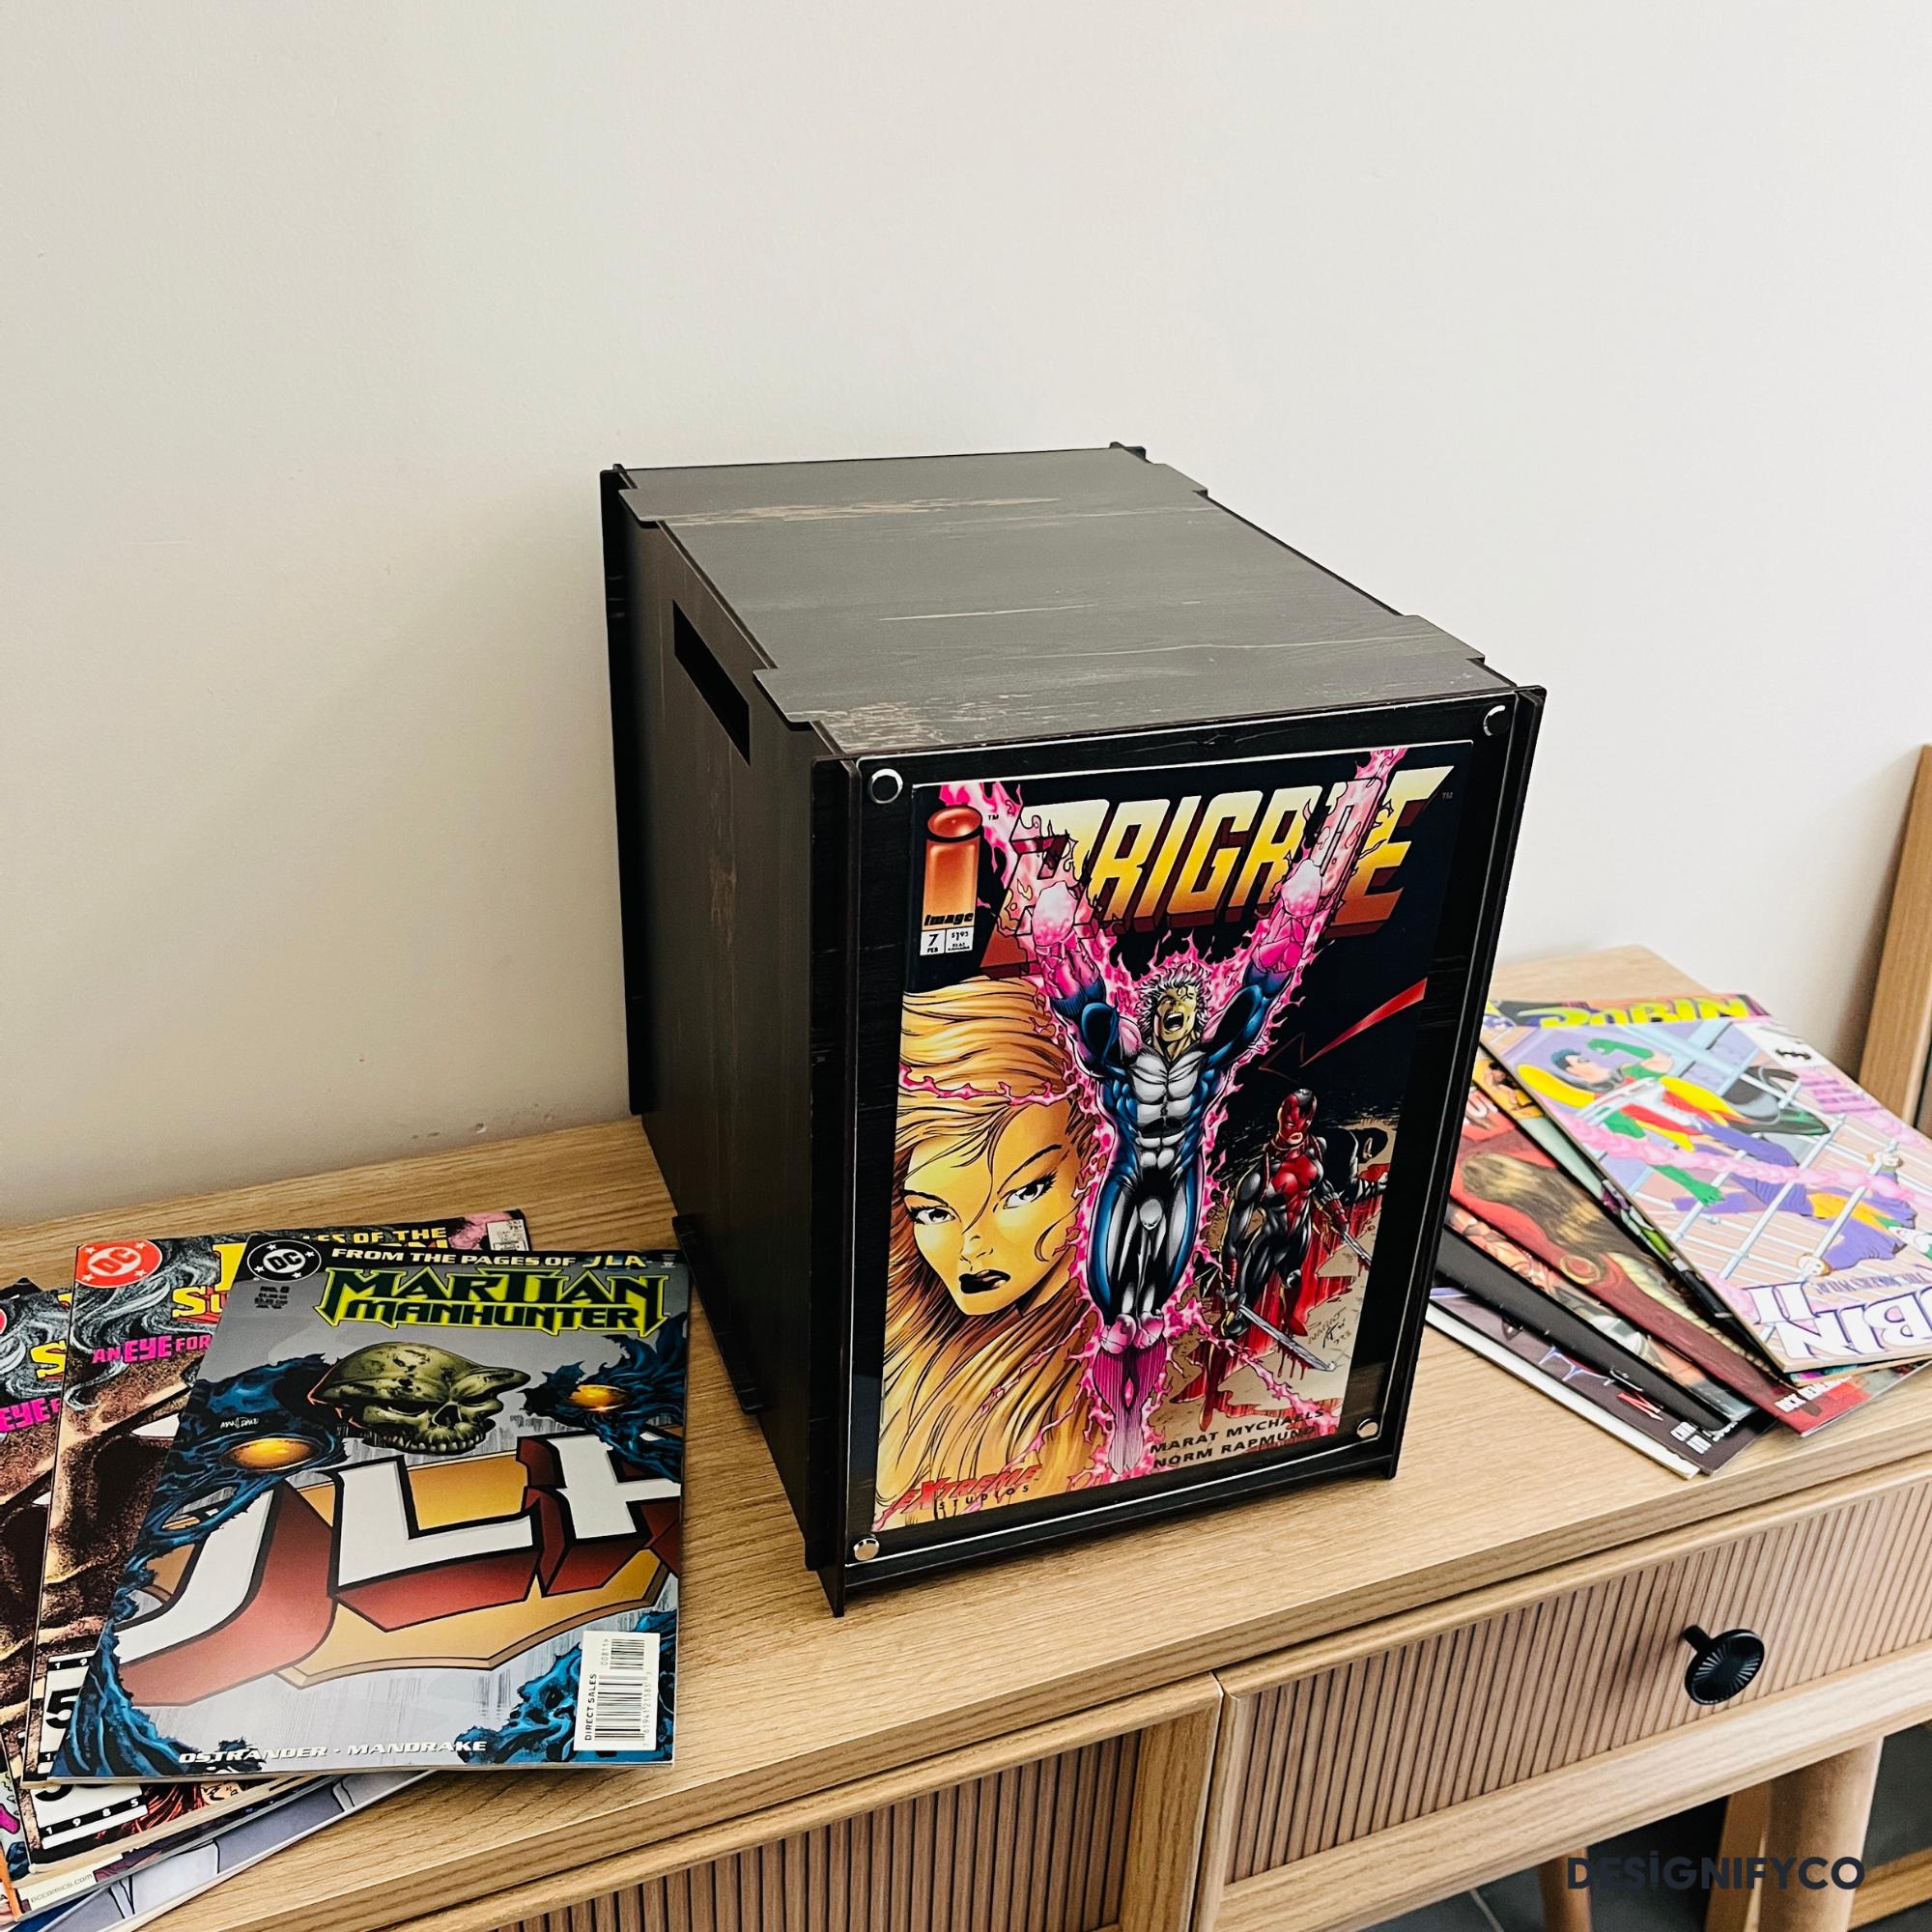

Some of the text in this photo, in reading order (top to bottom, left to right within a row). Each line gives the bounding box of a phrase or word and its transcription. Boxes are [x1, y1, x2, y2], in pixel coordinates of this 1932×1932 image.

[928, 934, 939, 946] 7
[354, 1232, 384, 1243] OF
[393, 1227, 447, 1240] THE
[91, 1248, 139, 1273] DC
[267, 1251, 302, 1271] DC
[331, 1248, 403, 1262] FROM
[410, 1252, 457, 1264] THE
[461, 1255, 540, 1266] PAGES
[545, 1257, 577, 1266] OF
[582, 1255, 647, 1268] JLA
[315, 1266, 669, 1329] MARTIAN
[340, 1297, 641, 1334] MANHUNTER
[1776, 1287, 1932, 1360] BIN
[92, 1333, 213, 1364] AN EYE FOR
[1150, 1432, 1219, 1454] MARAT
[1153, 1451, 1213, 1468] NORM
[887, 1463, 1043, 1514] EXTREME
[584, 1673, 597, 1741] DIRECT SALES
[179, 1741, 488, 1765] OSTRANDER MANDRAKE
